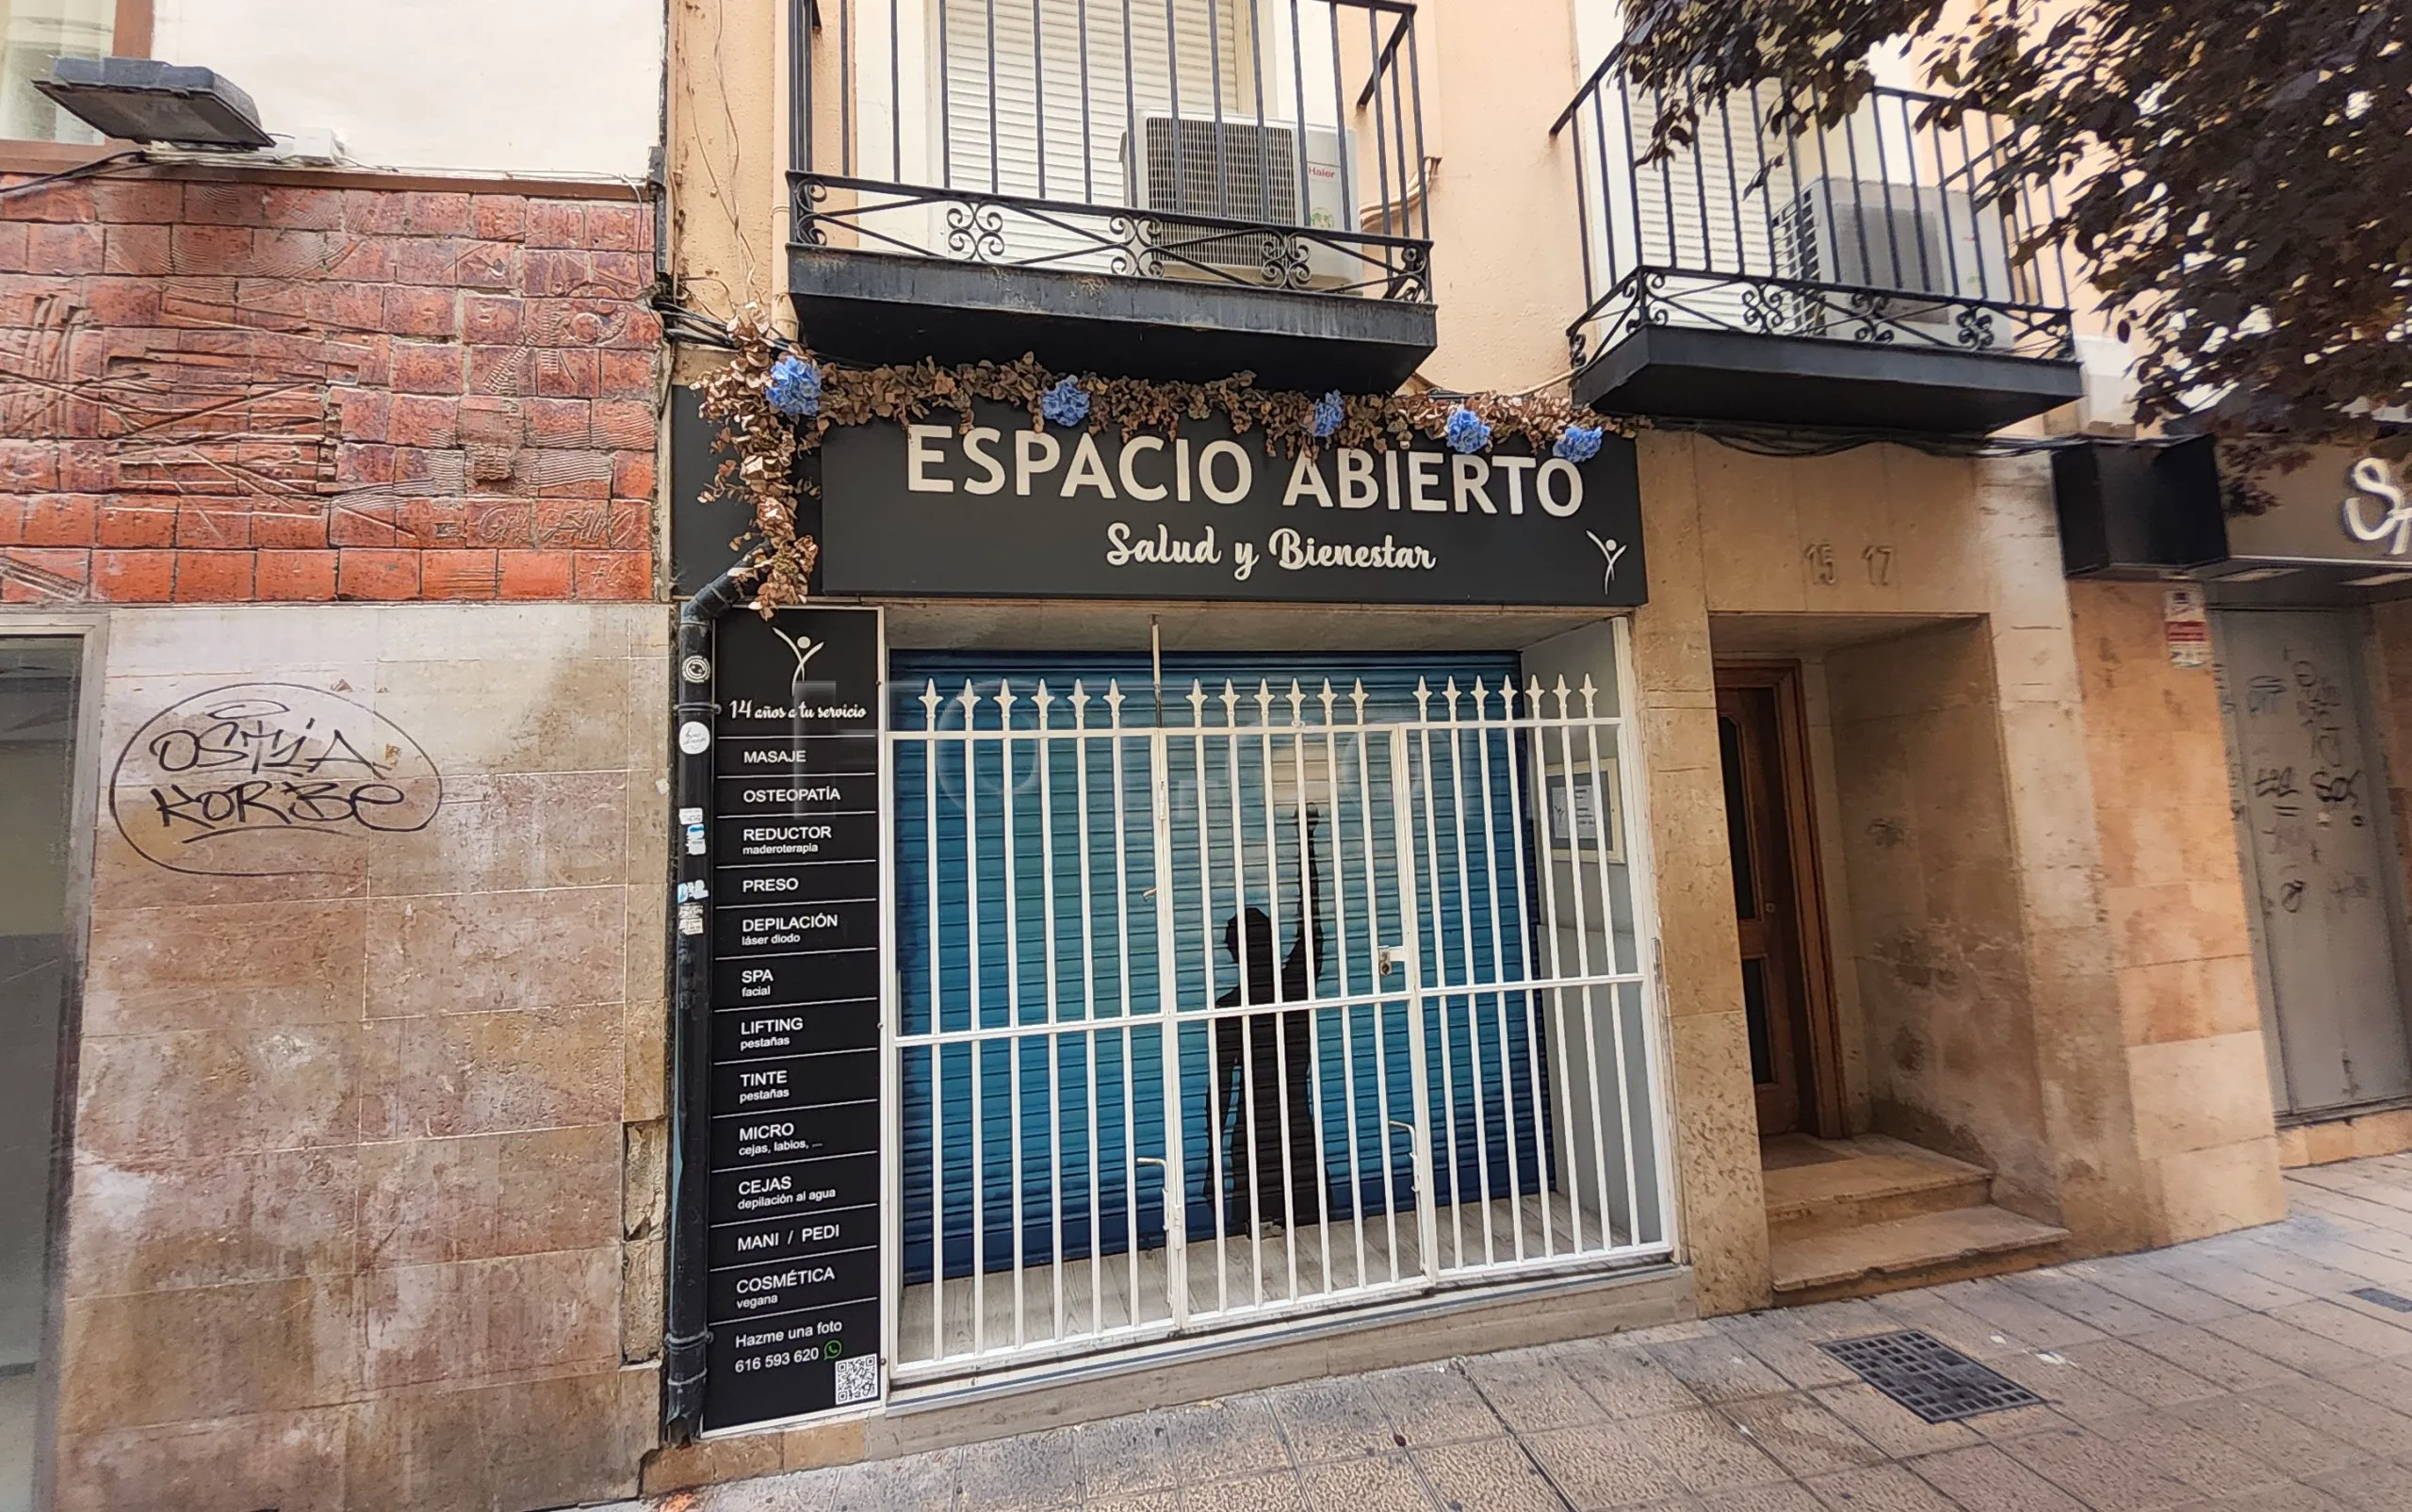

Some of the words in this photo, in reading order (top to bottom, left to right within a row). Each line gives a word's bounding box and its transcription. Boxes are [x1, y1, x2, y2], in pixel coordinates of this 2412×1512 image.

[907, 424, 1252, 504] ESPACIO
[1282, 447, 1584, 517] ABIERTO
[1106, 522, 1222, 566] Salud
[1233, 542, 1260, 581] y
[1268, 528, 1437, 570] Bienestar
[1806, 542, 1835, 586] 15
[1863, 544, 1893, 586] 17
[730, 699, 752, 719] 14
[754, 706, 787, 719] años
[798, 701, 815, 719] tu
[817, 704, 867, 718] servicio
[743, 750, 807, 763] MASAJE
[743, 786, 841, 803] OSTEOPATÍA
[743, 825, 832, 841] REDUCTOR
[742, 842, 819, 854] maderoterapia
[742, 877, 799, 893] PRESO
[742, 912, 838, 933] DEPILACIÓN
[742, 935, 768, 946] láser
[770, 933, 801, 944] diodo
[742, 968, 774, 984] SPA
[742, 984, 771, 998] facial
[741, 1016, 804, 1035] LIFTING
[740, 1036, 790, 1051] pestañas
[740, 1069, 788, 1087] TINTE
[739, 1088, 790, 1104] pestañas
[739, 1122, 794, 1142] MICRO
[738, 1144, 771, 1157] cejas,
[774, 1139, 809, 1152] labios,
[738, 1176, 791, 1195] CEJAS
[737, 1195, 793, 1211] depilación
[795, 1190, 807, 1202] al
[808, 1189, 837, 1202] agua
[738, 1232, 779, 1252] MANI
[787, 1229, 794, 1244] /
[802, 1224, 839, 1243] PEDI
[736, 1266, 836, 1293] COSMÉTICA
[736, 1294, 778, 1309] vegana
[735, 1331, 785, 1348] Hazme
[788, 1325, 813, 1340] una
[816, 1320, 842, 1335] foto
[735, 1357, 761, 1374] 616
[765, 1352, 790, 1368] 593
[793, 1347, 820, 1363] 620
